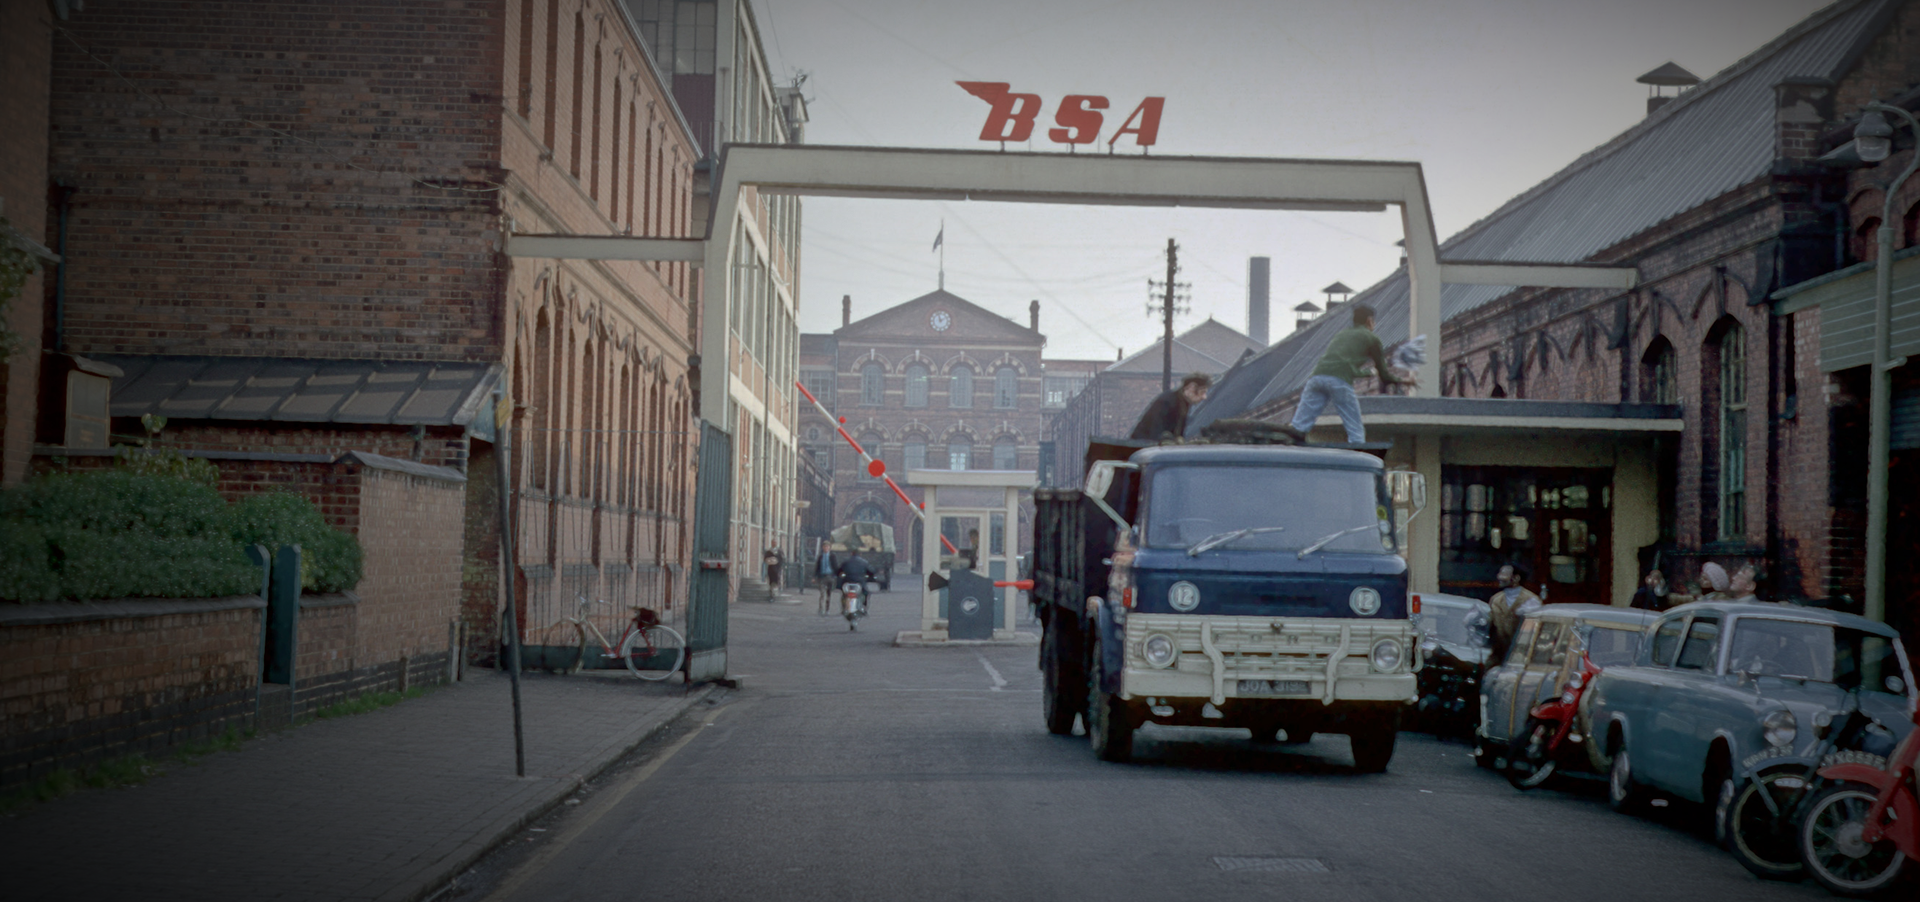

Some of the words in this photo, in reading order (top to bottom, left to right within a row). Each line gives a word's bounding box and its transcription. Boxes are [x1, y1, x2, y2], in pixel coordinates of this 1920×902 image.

[955, 81, 1166, 146] BSA
[1177, 587, 1193, 605] 12
[1357, 591, 1374, 609] 12
